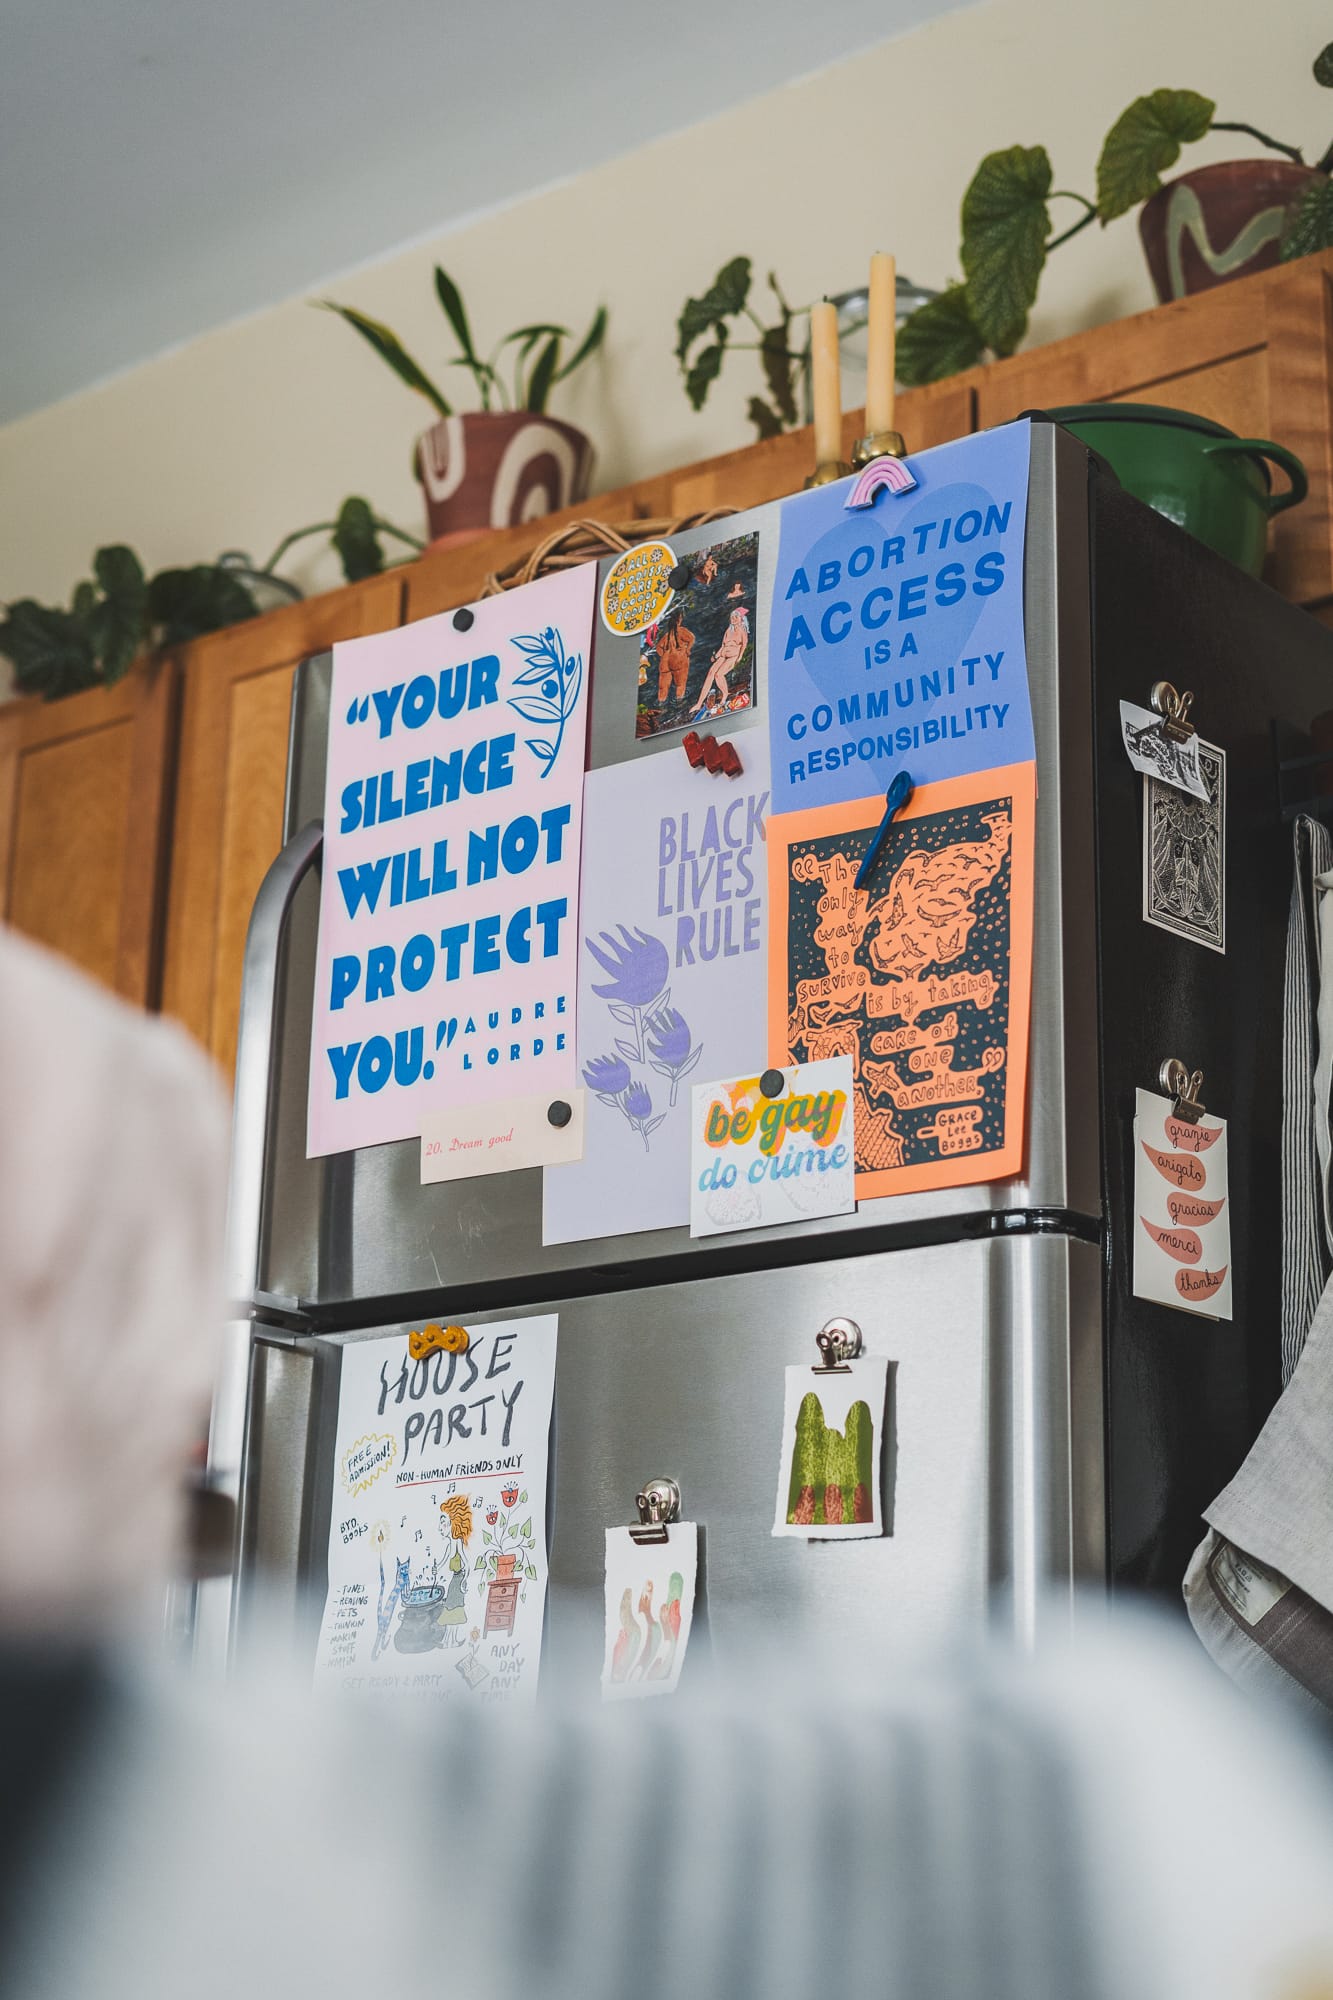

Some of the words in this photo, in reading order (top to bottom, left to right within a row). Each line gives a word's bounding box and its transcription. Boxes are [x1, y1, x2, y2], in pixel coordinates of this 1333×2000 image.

[627, 553, 648, 572] ALL
[785, 501, 1012, 600] ABORTION
[618, 564, 662, 592] BODIES
[629, 578, 652, 596] ARE
[615, 597, 657, 624] BODIES
[621, 591, 652, 610] GOOD
[783, 551, 1005, 661] ACCESS
[864, 639, 891, 670] IS
[899, 632, 919, 657] A
[346, 655, 500, 739] “YOUR
[787, 651, 1005, 740] COMMUNITY
[789, 704, 1010, 784] RESPONSIBILITY
[340, 733, 515, 834] SILENCE
[659, 791, 770, 867] BLACK
[337, 839, 457, 920] WILL
[467, 804, 571, 886] NOT
[658, 845, 754, 917] LIVES
[820, 887, 864, 919] only
[675, 898, 761, 968] RULE
[818, 921, 863, 946] way
[330, 897, 567, 1011] PROTECT
[828, 946, 849, 968] to
[868, 992, 883, 1015] is
[892, 987, 918, 1017] by
[928, 975, 994, 1006] taking
[464, 996, 565, 1034] AUDRE
[931, 1014, 955, 1038] of
[463, 1033, 565, 1070] LORDE
[706, 1102, 752, 1144] be
[758, 1092, 839, 1153] gay
[947, 1125, 967, 1138] Lee
[426, 1141, 443, 1156] 20.
[449, 1137, 483, 1153] Dream
[488, 1128, 514, 1149] good
[698, 1157, 738, 1192] do
[747, 1144, 849, 1185] crime
[1157, 1156, 1202, 1186] arigato
[1170, 1201, 1215, 1226] gracias
[1156, 1231, 1199, 1256] merci
[1178, 1269, 1220, 1292] thanks
[377, 1333, 518, 1416] HOUSE
[401, 1380, 524, 1467] PARTY
[347, 1443, 372, 1473] FREE
[496, 1453, 523, 1470] ONLY
[337, 1607, 358, 1618] PETS
[490, 1642, 520, 1658] ANY
[499, 1656, 525, 1673] DAY
[490, 1675, 520, 1690] ANY
